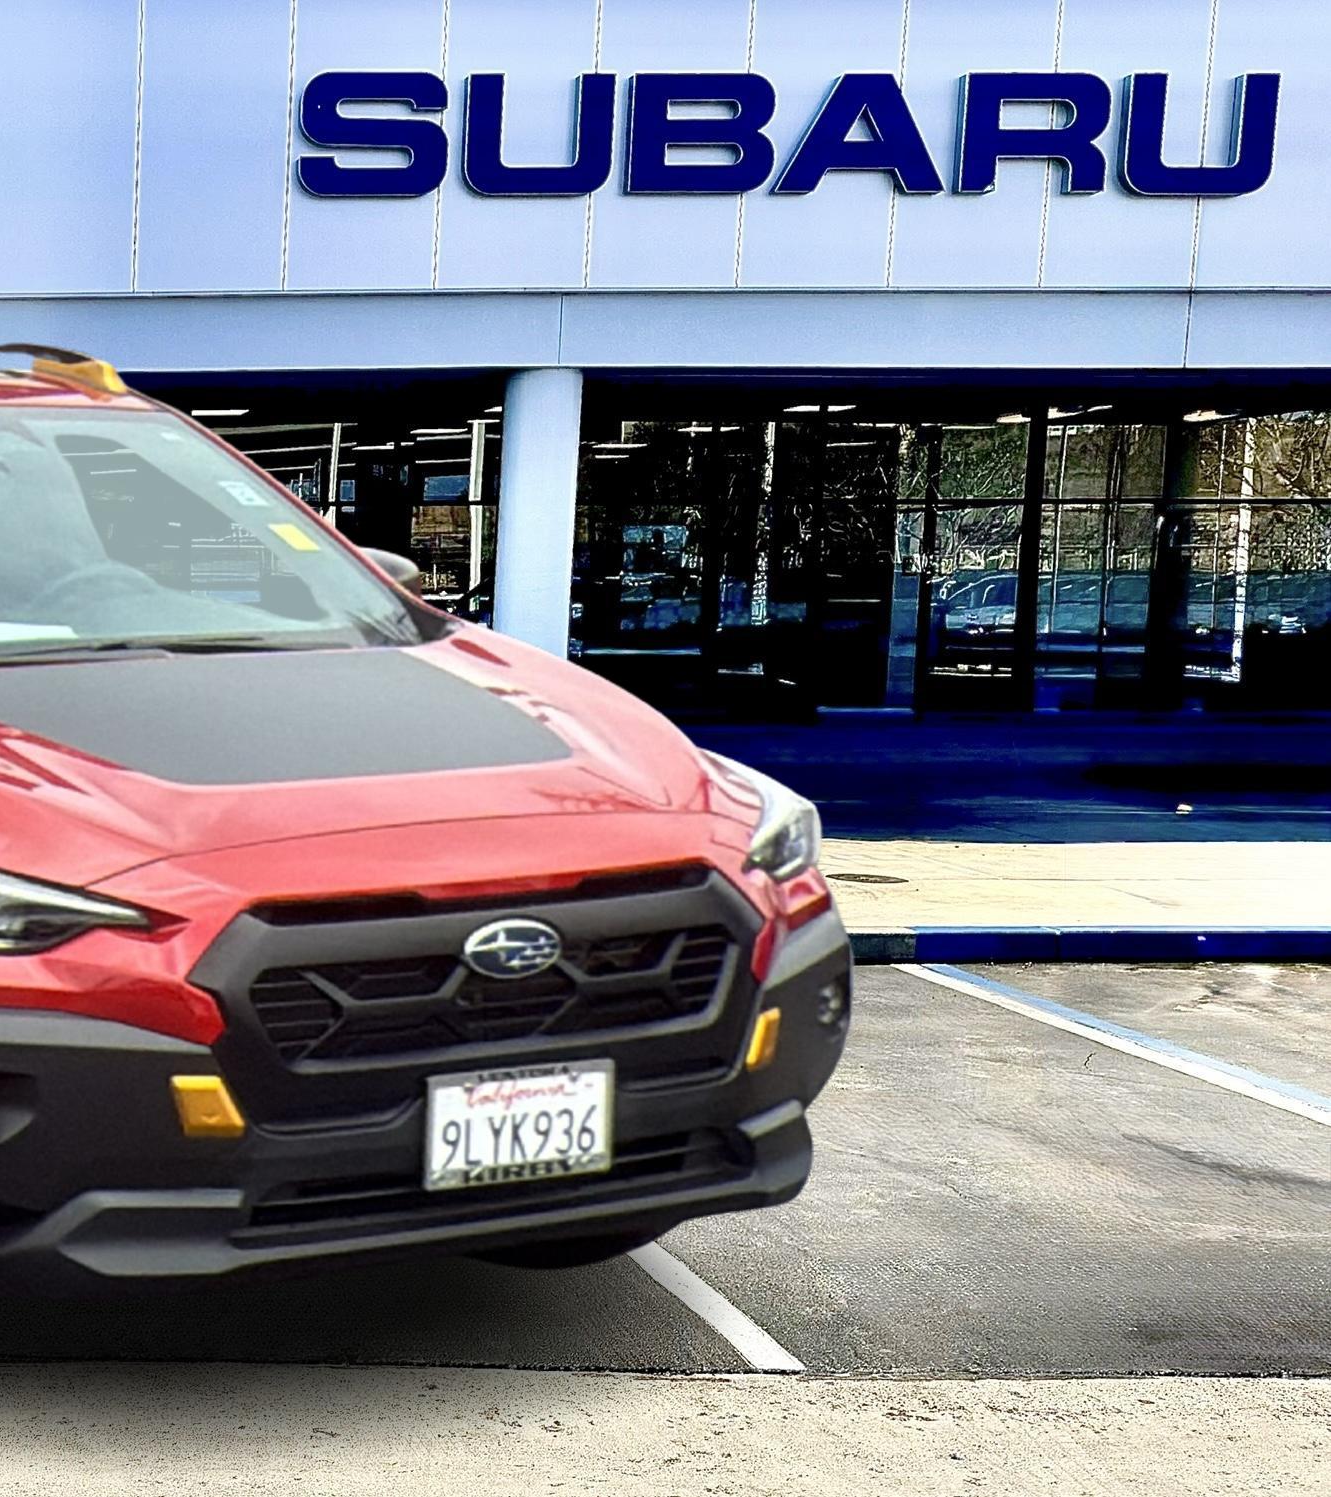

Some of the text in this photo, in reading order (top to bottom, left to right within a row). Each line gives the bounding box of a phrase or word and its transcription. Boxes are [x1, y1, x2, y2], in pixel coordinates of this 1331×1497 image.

[297, 70, 1281, 197] SUBARU
[442, 1104, 597, 1169] 9LYK936
[463, 1157, 574, 1183] KIRBY
